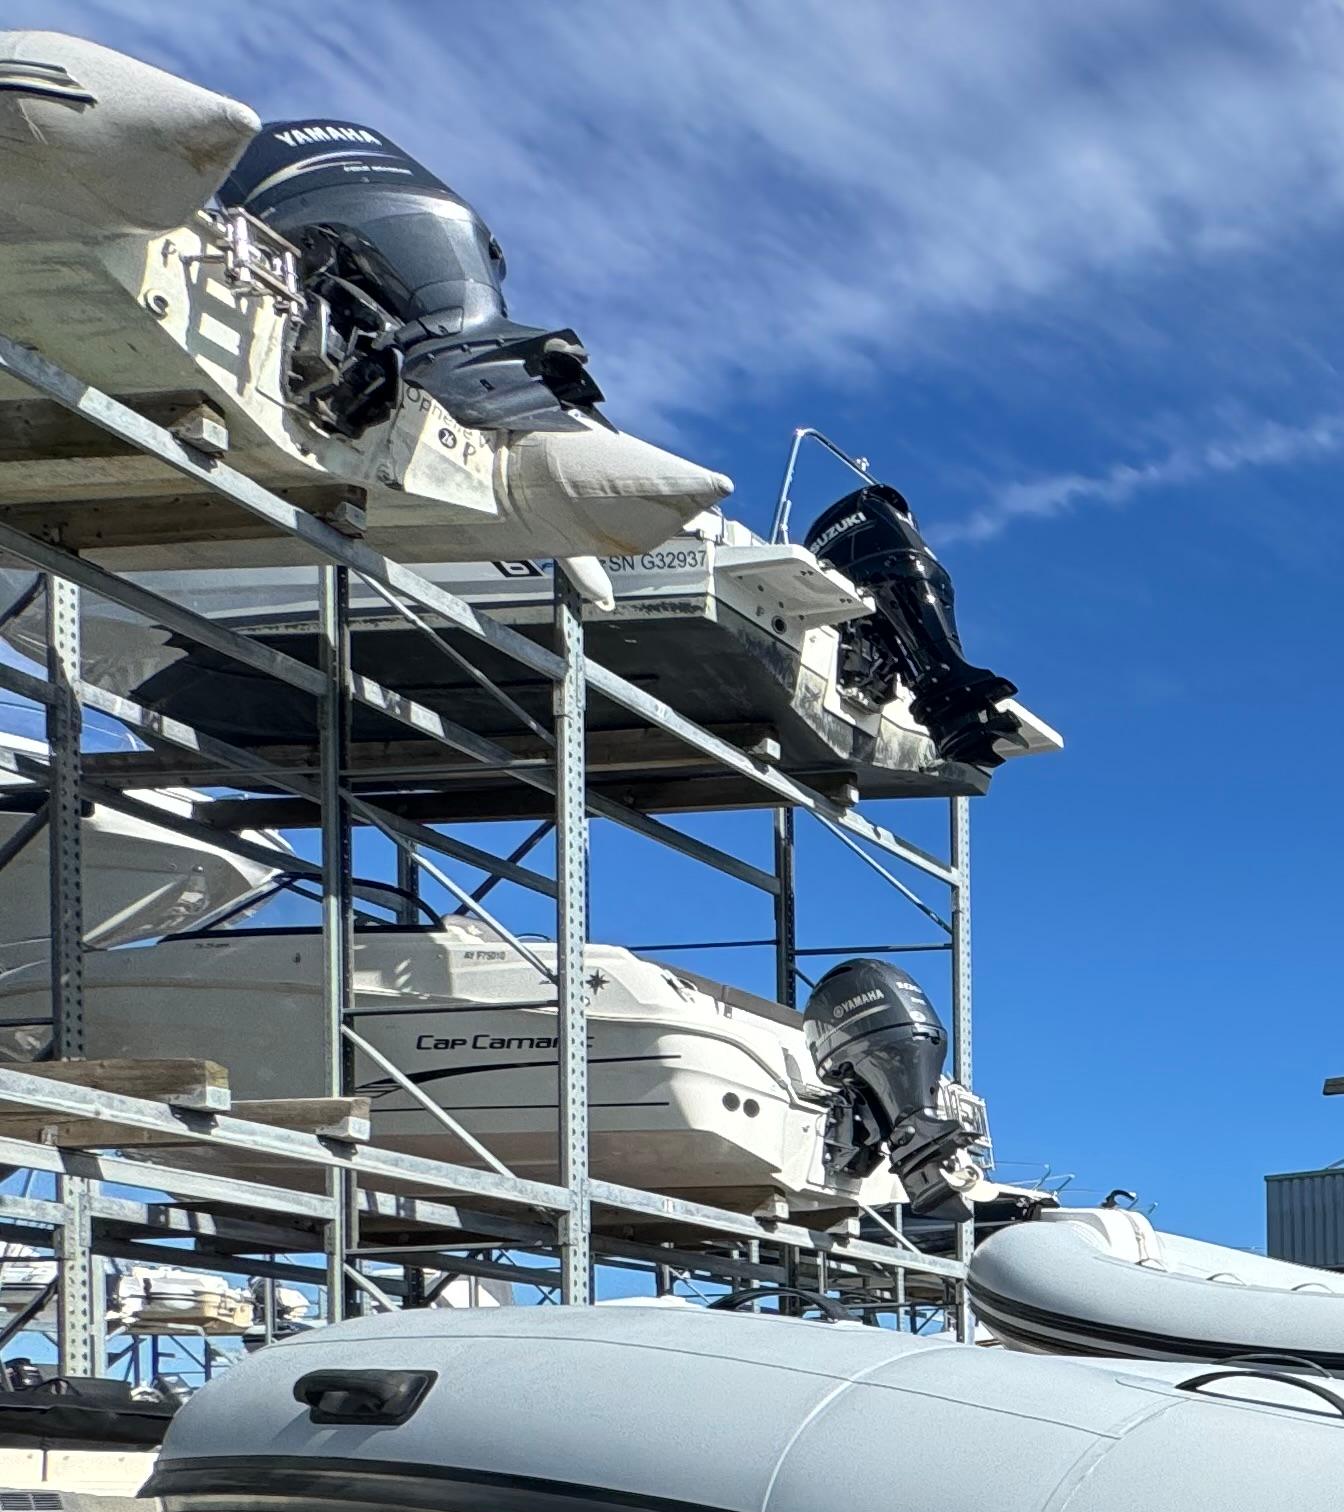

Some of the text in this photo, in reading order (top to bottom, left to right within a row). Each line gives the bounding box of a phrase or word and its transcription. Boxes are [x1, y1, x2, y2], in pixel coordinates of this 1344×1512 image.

[273, 126, 383, 147] YAMAHA
[809, 511, 867, 554] SUZUKI
[641, 551, 706, 570] G32937
[840, 989, 885, 1012] YAMAHA
[471, 1033, 595, 1050] Camar
